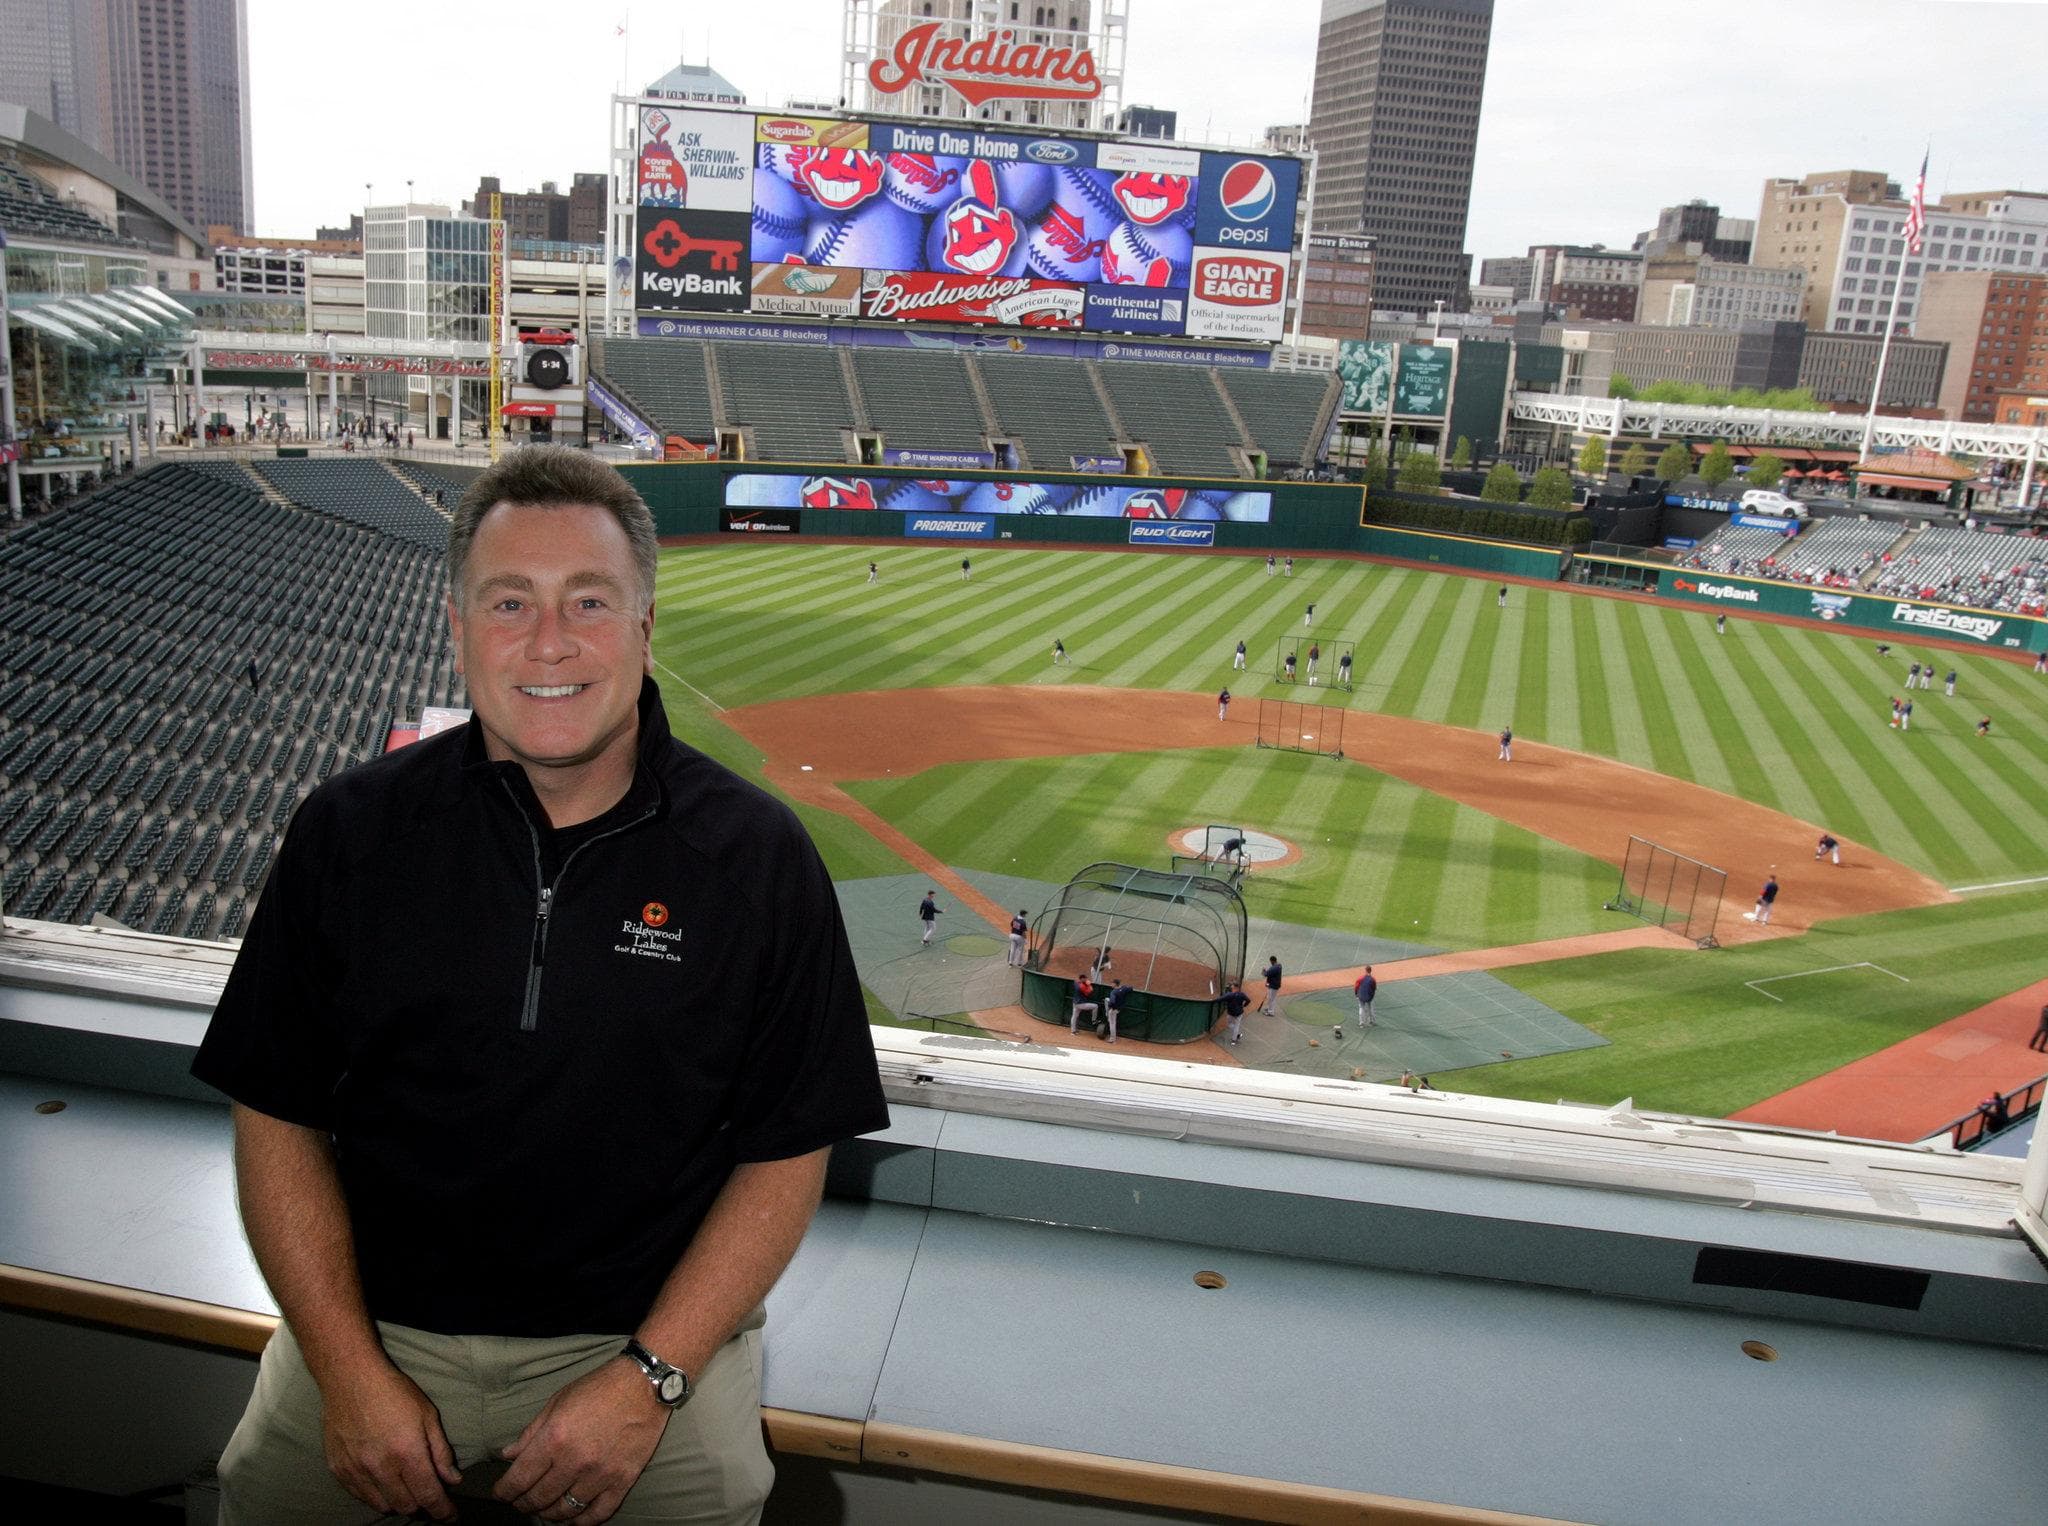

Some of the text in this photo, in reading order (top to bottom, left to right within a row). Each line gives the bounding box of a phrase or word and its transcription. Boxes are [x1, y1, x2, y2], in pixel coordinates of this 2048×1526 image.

[868, 22, 1102, 106] Indians
[763, 122, 813, 138] Sugardale
[678, 132, 702, 146] ASK
[893, 128, 1018, 159] Drive One Home
[683, 148, 740, 164] SHERWIN-
[1036, 144, 1067, 160] Ford
[644, 158, 673, 167] COVER
[651, 165, 667, 173] THE
[644, 172, 672, 180] EARTH
[690, 164, 745, 180] WILLIAMS
[1219, 227, 1269, 245] pepsi
[1203, 263, 1277, 282] GIANT
[642, 271, 743, 298] KeyBank
[1203, 280, 1273, 299] EAGLE
[863, 276, 1031, 317] Budweiser
[1089, 295, 1160, 309] Continental
[757, 297, 853, 315] Medical Mutual
[1004, 294, 1080, 317] American Lager
[1112, 307, 1159, 321] Airlines
[1191, 309, 1280, 322] Official supermarket
[677, 324, 828, 341] TIME WARNER CABLE Bleachers
[1203, 321, 1214, 329] of
[1215, 322, 1229, 331] the
[1121, 346, 1255, 364] TIME WARNER CABLE Bleachers
[930, 455, 957, 463] WARNER
[1682, 498, 1729, 511] 5:34 PM
[912, 520, 987, 532] PROGRESSIVE
[1132, 527, 1212, 538] BUD LIGHT
[1698, 582, 1760, 602] KeyBank
[1891, 603, 2003, 637] FirstEnergy
[621, 920, 682, 941] Ridgewood
[633, 935, 668, 952] Lakes
[614, 944, 630, 953] Golf
[638, 948, 665, 959] Country
[666, 953, 682, 962] Club
